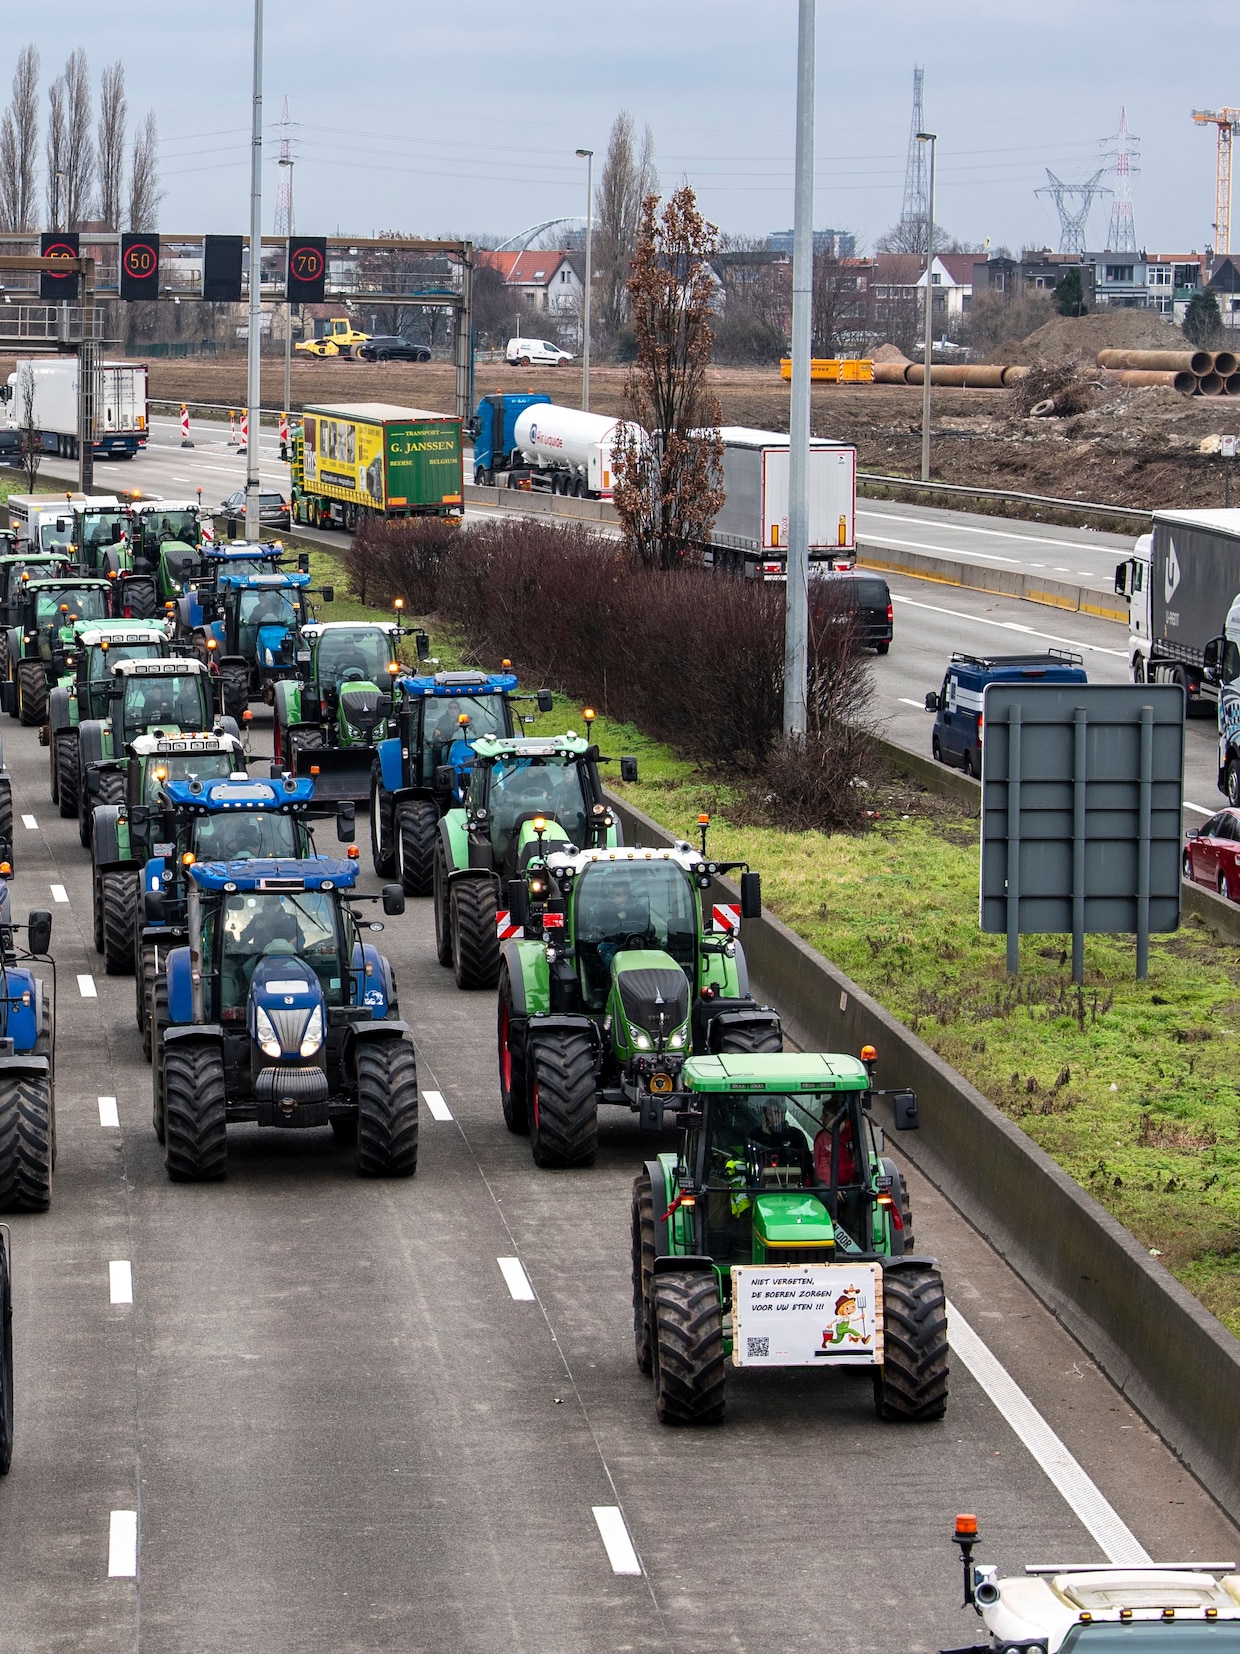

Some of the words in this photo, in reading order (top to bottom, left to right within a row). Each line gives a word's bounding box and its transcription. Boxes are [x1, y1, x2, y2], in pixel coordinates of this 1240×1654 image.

[130, 253, 150, 270] 50
[298, 256, 316, 273] 70
[391, 443, 402, 452] G.
[405, 441, 455, 454] JANSSEN
[751, 1278, 770, 1286] NIET
[772, 1278, 815, 1286] VERGETEN,
[798, 1290, 832, 1298] ZORGEN
[792, 1303, 813, 1311] ETEN
